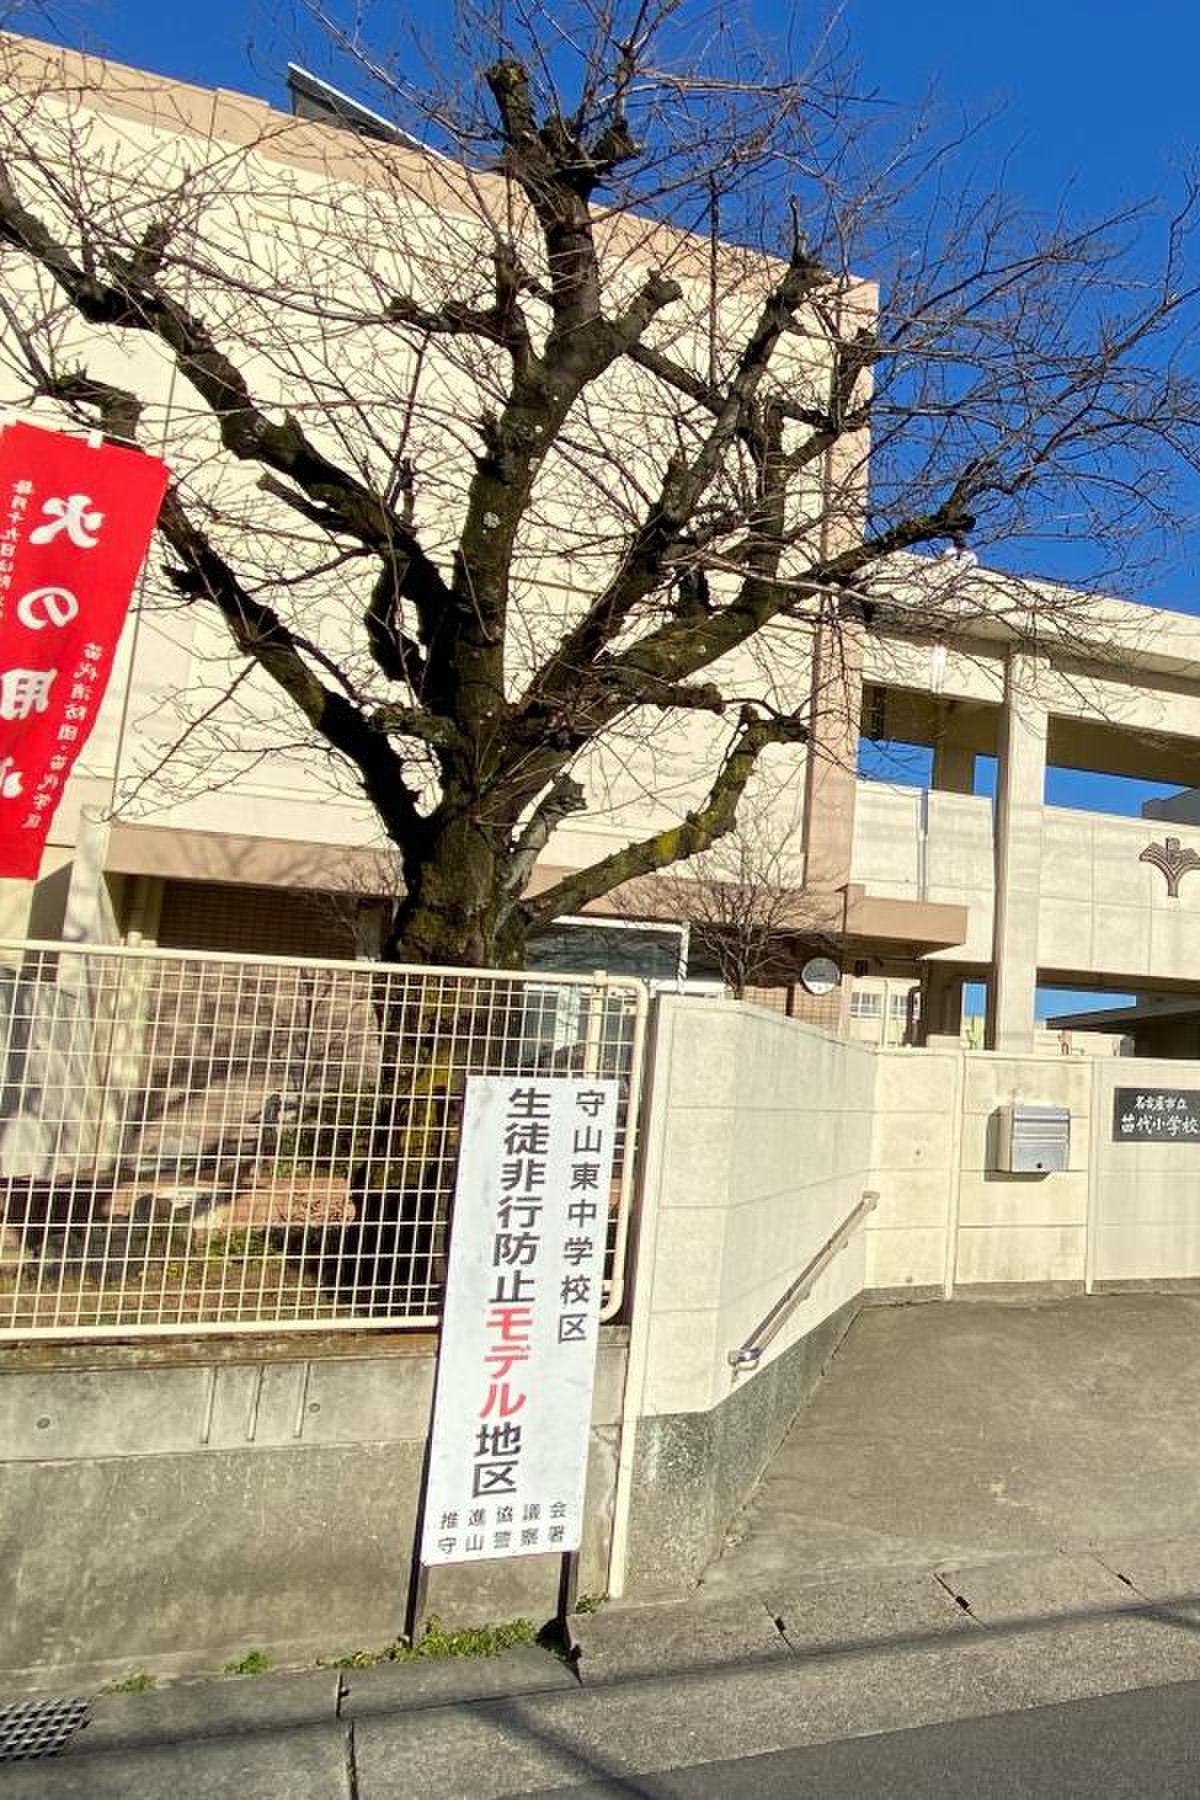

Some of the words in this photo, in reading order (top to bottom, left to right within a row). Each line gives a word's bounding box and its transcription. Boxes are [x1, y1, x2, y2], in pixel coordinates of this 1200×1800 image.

[1134, 1095, 1188, 1112] 名古屋市立
[1121, 1112, 1200, 1137] 苗代小学校
[558, 1089, 605, 1344] 守山東中学校区
[472, 1087, 552, 1498] 生徒非行防止モデル地区
[440, 1501, 567, 1530] 推進協議会
[438, 1524, 565, 1554] 守山警察署
